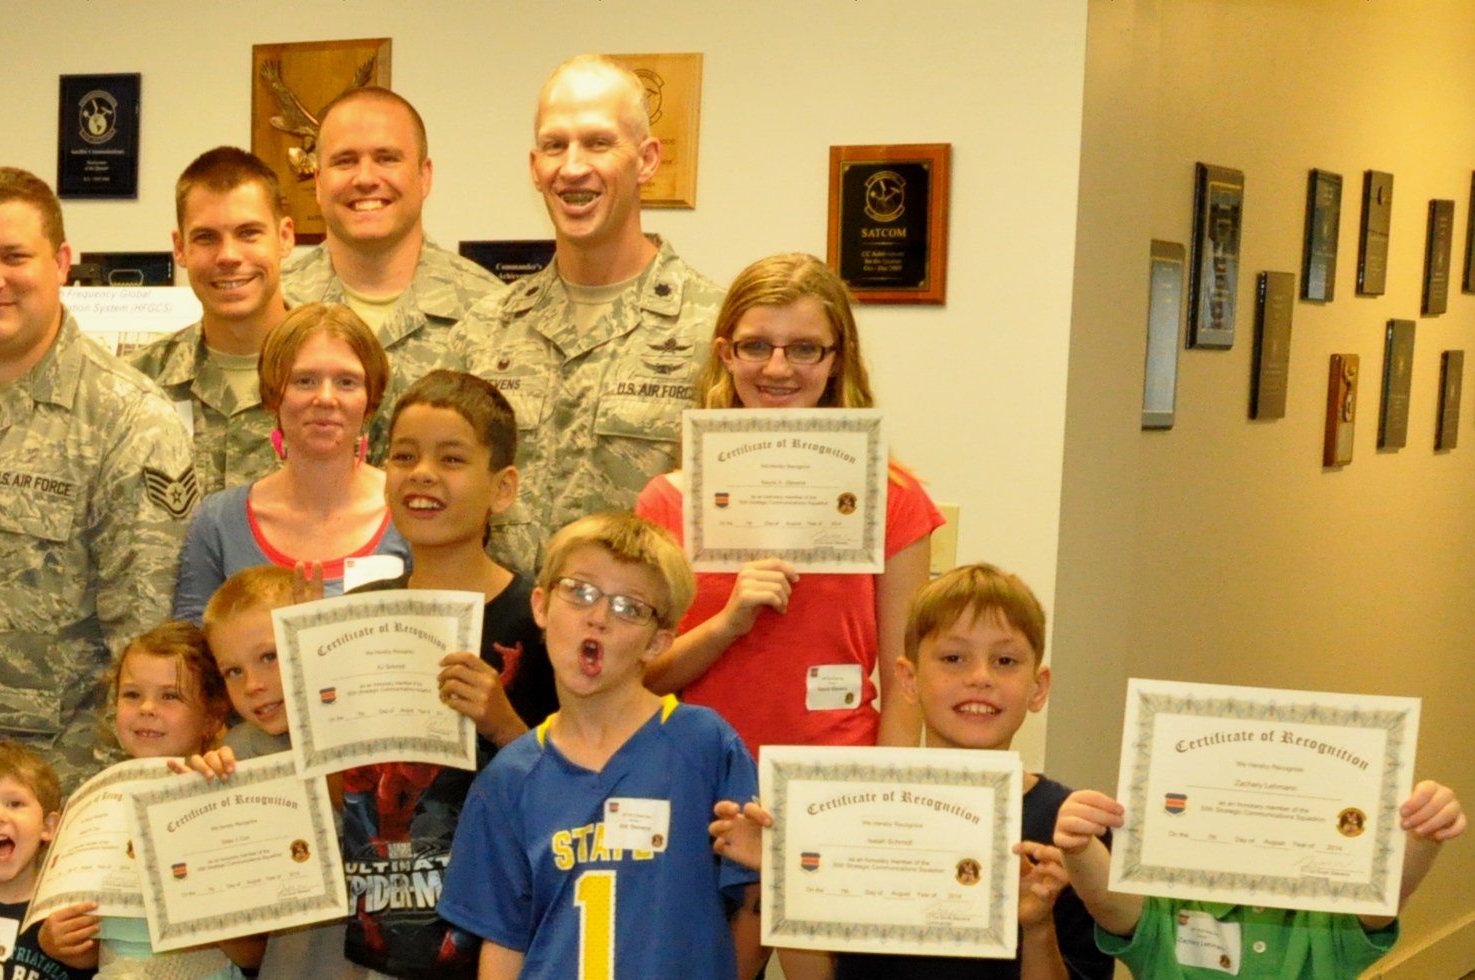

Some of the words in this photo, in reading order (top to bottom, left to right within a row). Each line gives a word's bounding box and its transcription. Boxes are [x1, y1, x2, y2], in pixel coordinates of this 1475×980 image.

[861, 228, 907, 238] SATCOM
[495, 263, 542, 271] Commander's
[67, 290, 117, 300] Frequency
[120, 289, 153, 298] Global
[93, 303, 128, 314] System
[639, 384, 659, 397] AIR
[661, 385, 692, 399] FORC
[718, 441, 772, 462] Certificate
[777, 439, 787, 448] of
[791, 438, 856, 464] Recognition
[12, 474, 31, 489] AIR
[34, 477, 73, 497] FORCE
[317, 627, 374, 657] Certificate
[379, 623, 389, 633] of
[393, 622, 447, 651] Recognition
[1175, 731, 1254, 753] Certificate
[1261, 730, 1275, 742] of
[1280, 730, 1369, 771] Recognition
[167, 801, 217, 832] Certificate
[221, 797, 231, 808] of
[235, 794, 298, 810] Recognition
[807, 793, 878, 815] Certificate
[882, 791, 895, 801] of
[901, 791, 981, 825] Recognition
[552, 822, 654, 870] STA
